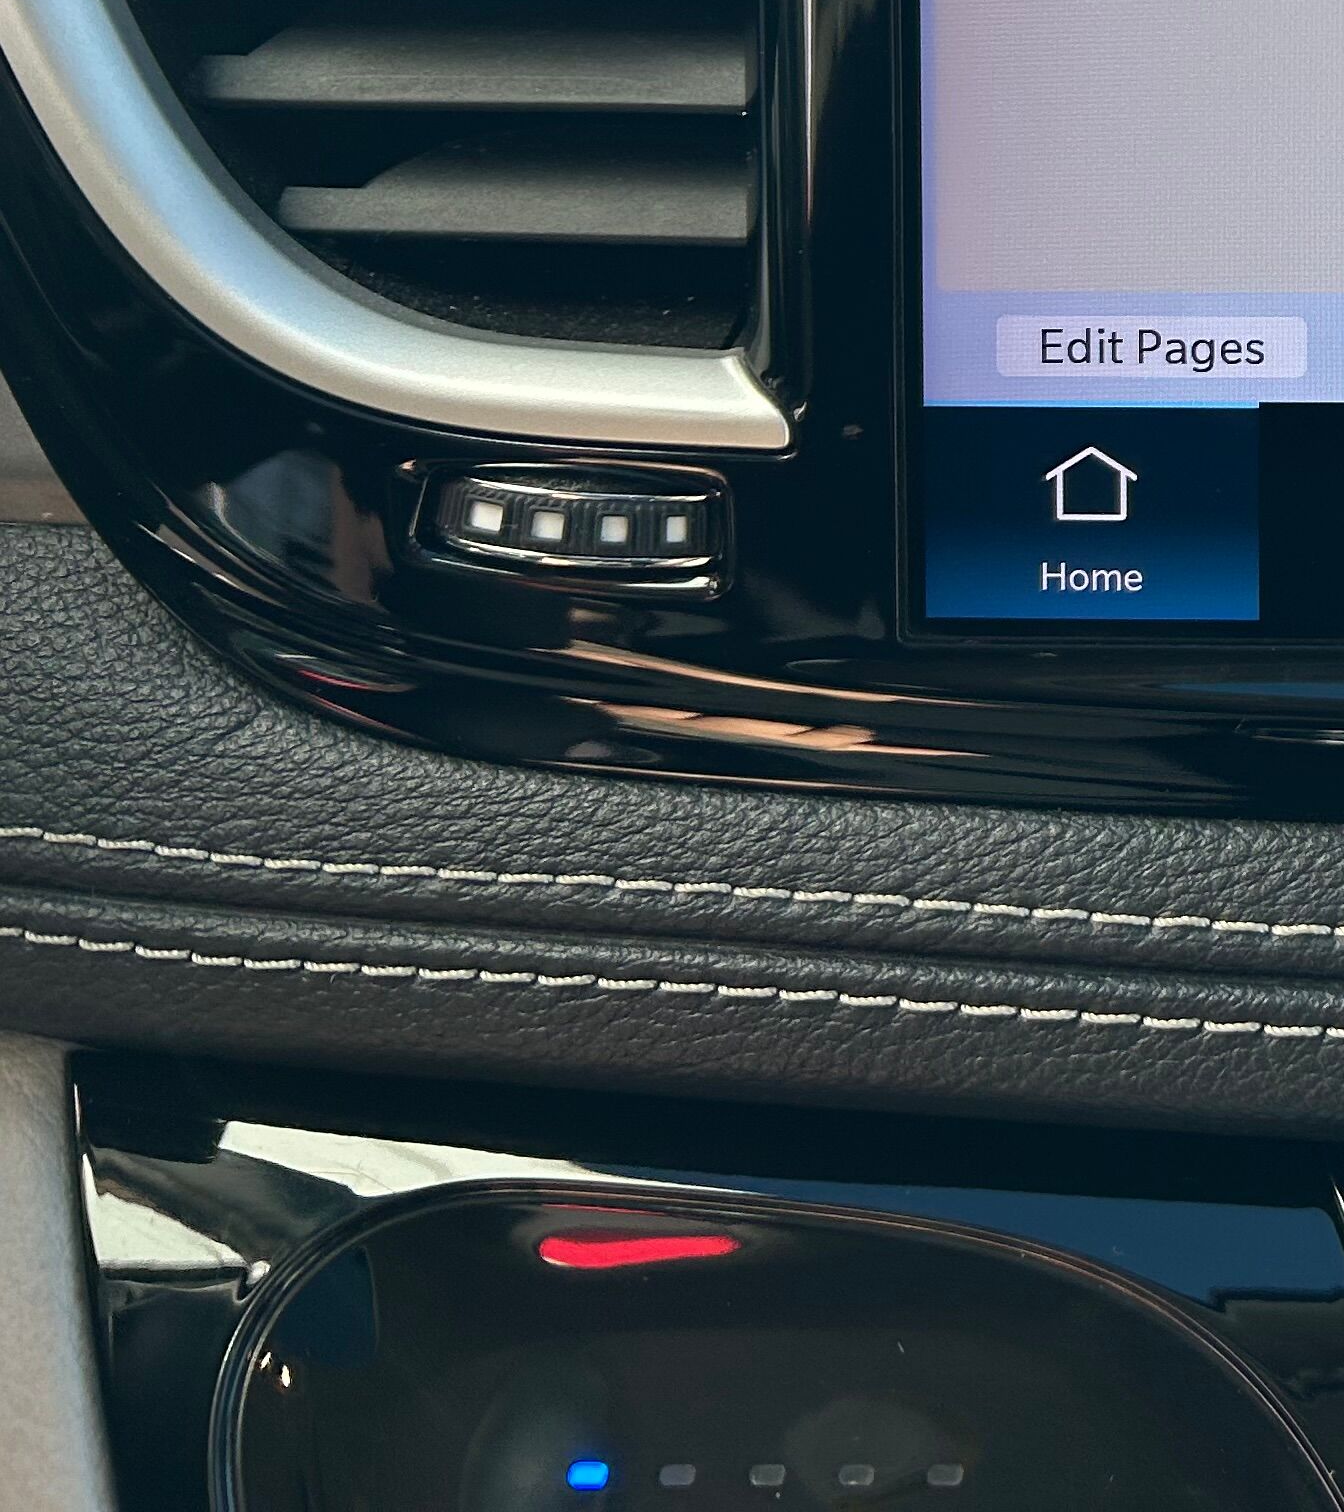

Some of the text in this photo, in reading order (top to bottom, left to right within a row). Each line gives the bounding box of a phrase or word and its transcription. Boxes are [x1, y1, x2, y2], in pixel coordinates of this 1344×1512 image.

[1041, 327, 1265, 373] Edit Pages
[1042, 562, 1143, 592] Home
